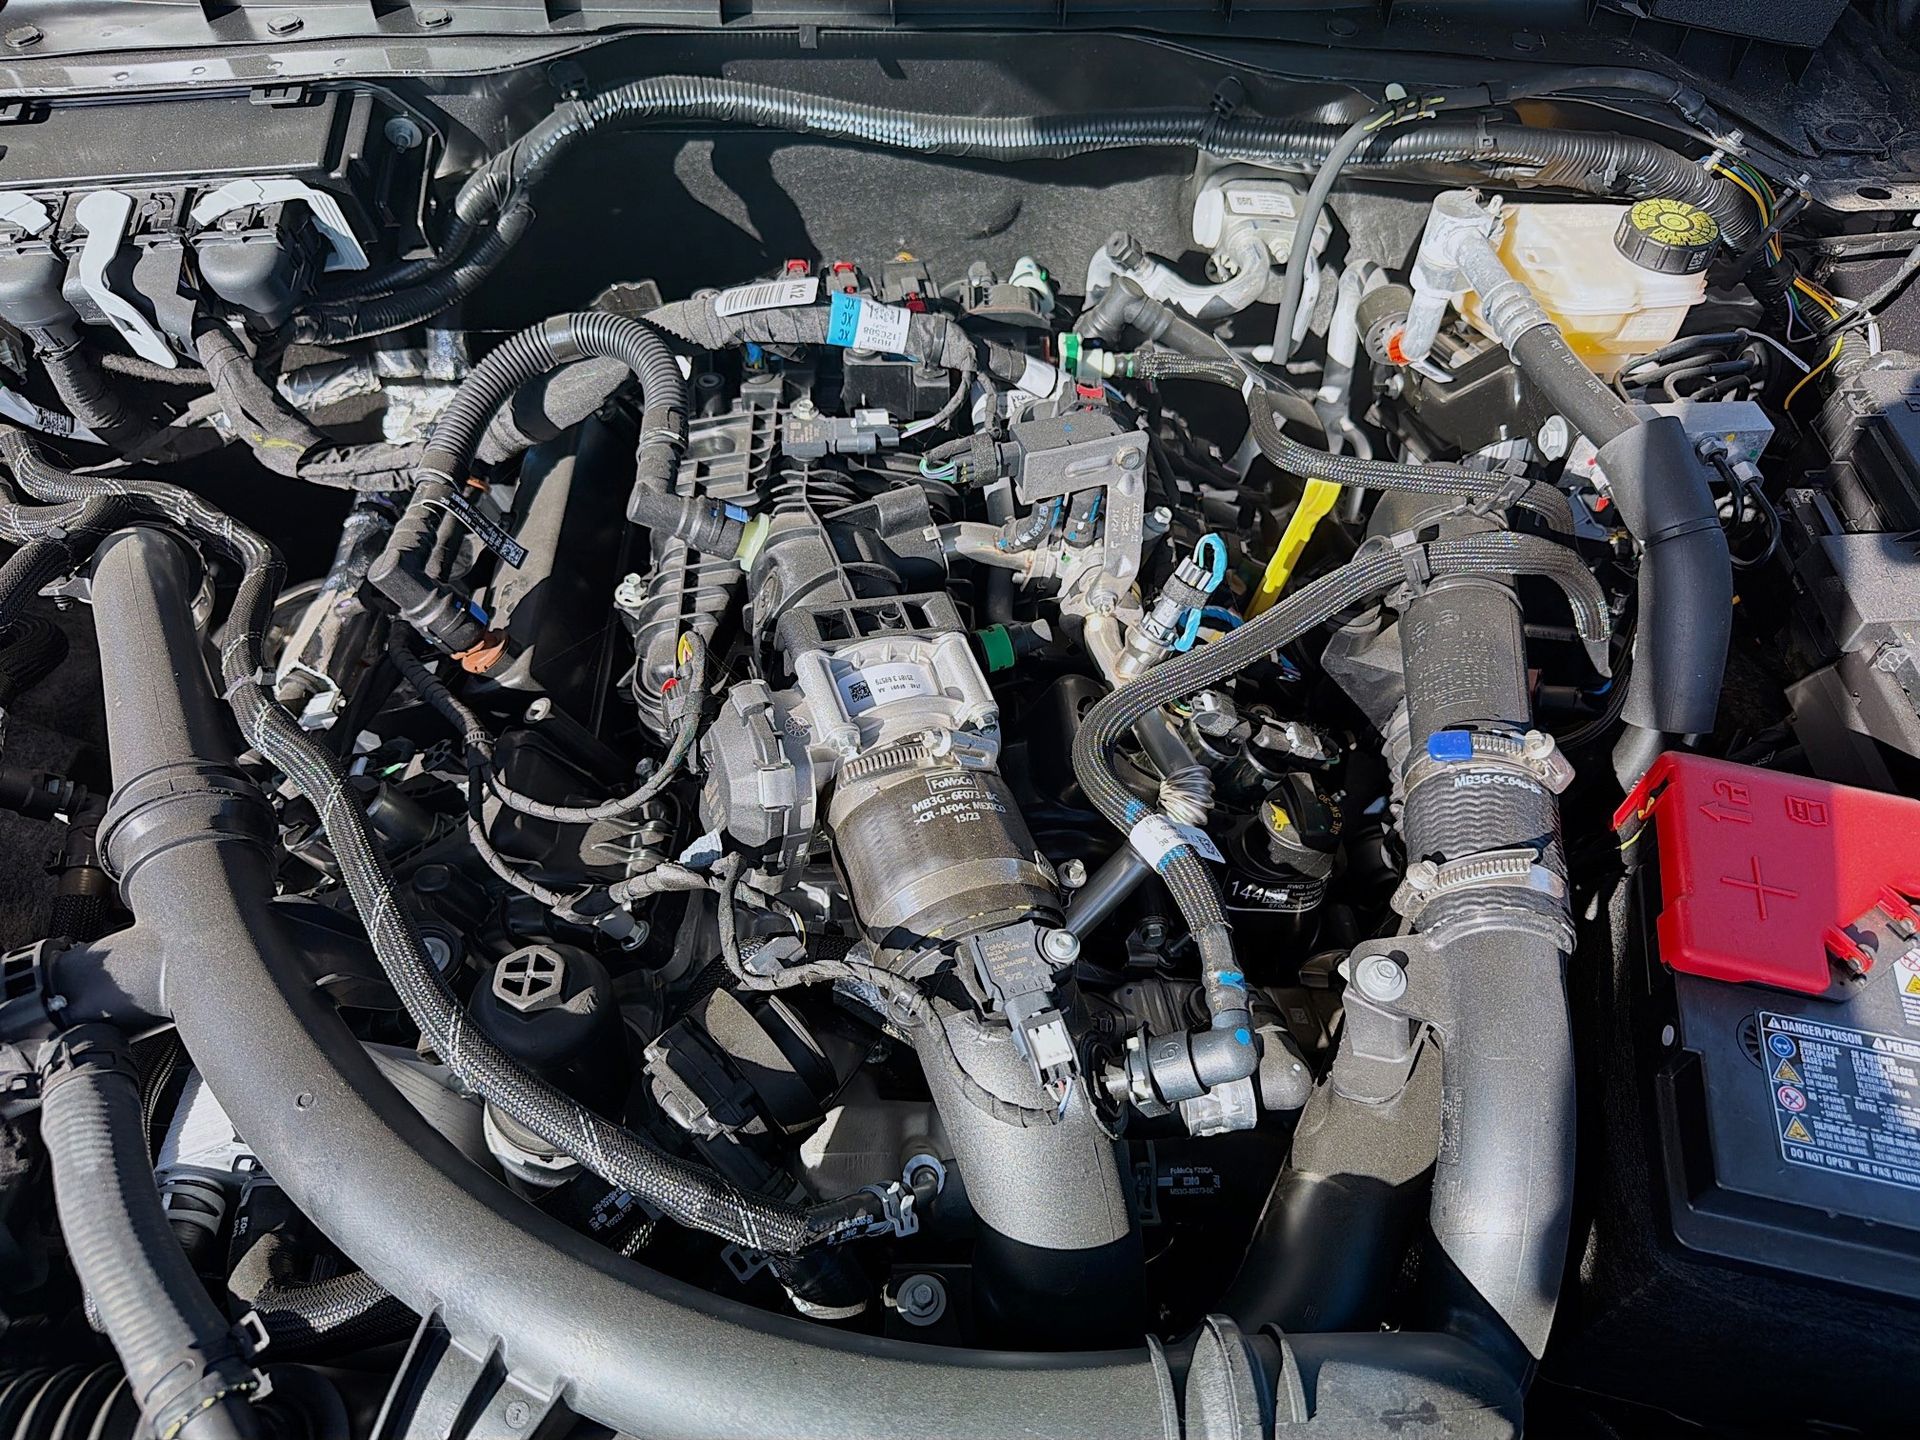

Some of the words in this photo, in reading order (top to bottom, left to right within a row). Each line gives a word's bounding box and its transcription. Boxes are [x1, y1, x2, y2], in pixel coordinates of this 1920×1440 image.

[844, 297, 855, 311] XC
[840, 312, 853, 326] XC
[838, 328, 850, 341] XC
[931, 776, 972, 789] FoMoCo
[972, 801, 1007, 814] MEXICO
[954, 812, 980, 824] 15/23
[1780, 1019, 1862, 1045] DANGER/POISON
[1799, 1040, 1822, 1051] SHIELD
[1800, 1048, 1836, 1061] EXPLOSIVE
[1801, 1055, 1823, 1066] GASES
[1803, 1063, 1823, 1073] CAUSE
[1804, 1070, 1839, 1084] BLINDNESS
[1823, 1102, 1848, 1113] FLAMES
[1824, 1110, 1853, 1122] SMOKING
[1825, 1140, 1848, 1152] SEVERE
[1790, 1147, 1804, 1159] DO
[1805, 1150, 1824, 1163] NOT
[1858, 1162, 1871, 1174] NE
